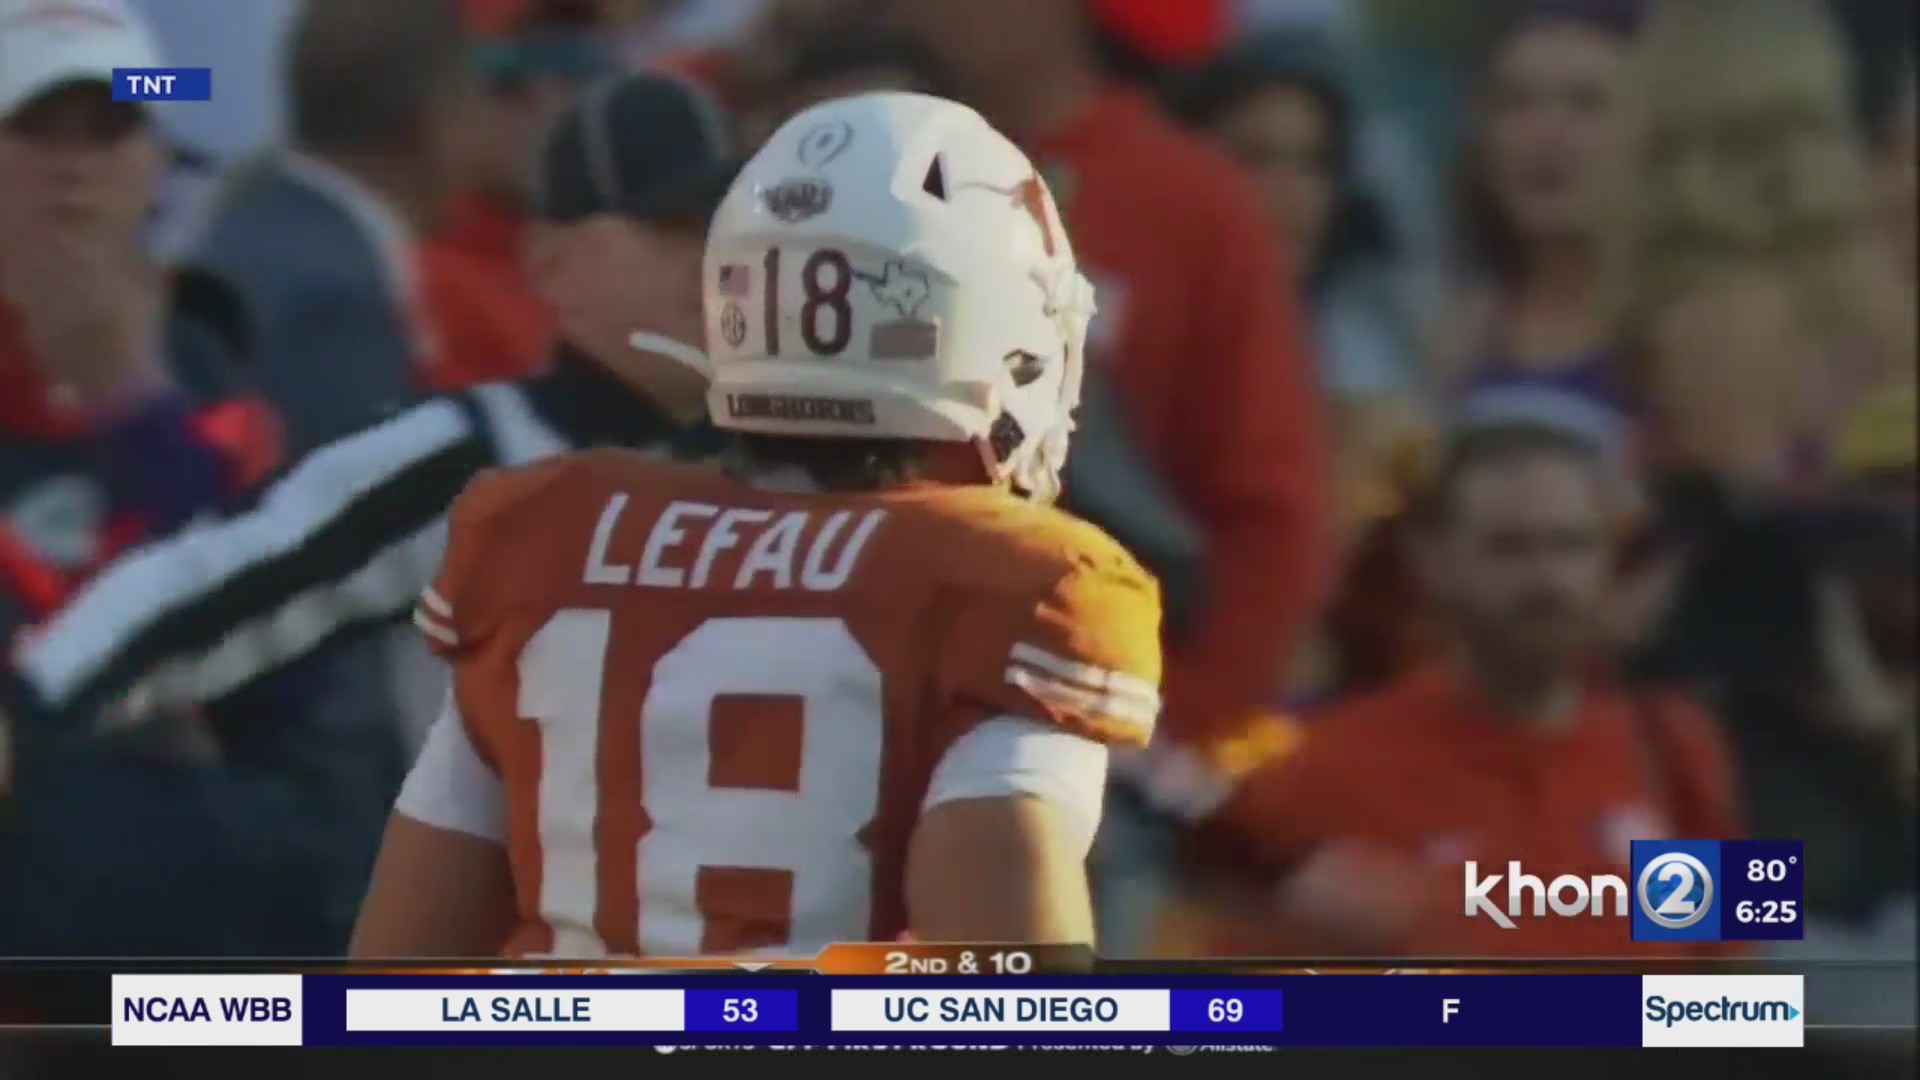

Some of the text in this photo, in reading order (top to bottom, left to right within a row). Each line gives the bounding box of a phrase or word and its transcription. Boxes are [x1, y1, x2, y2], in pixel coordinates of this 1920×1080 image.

[764, 247, 852, 356] 18
[583, 492, 888, 592] LEFAU
[516, 608, 883, 957] 18
